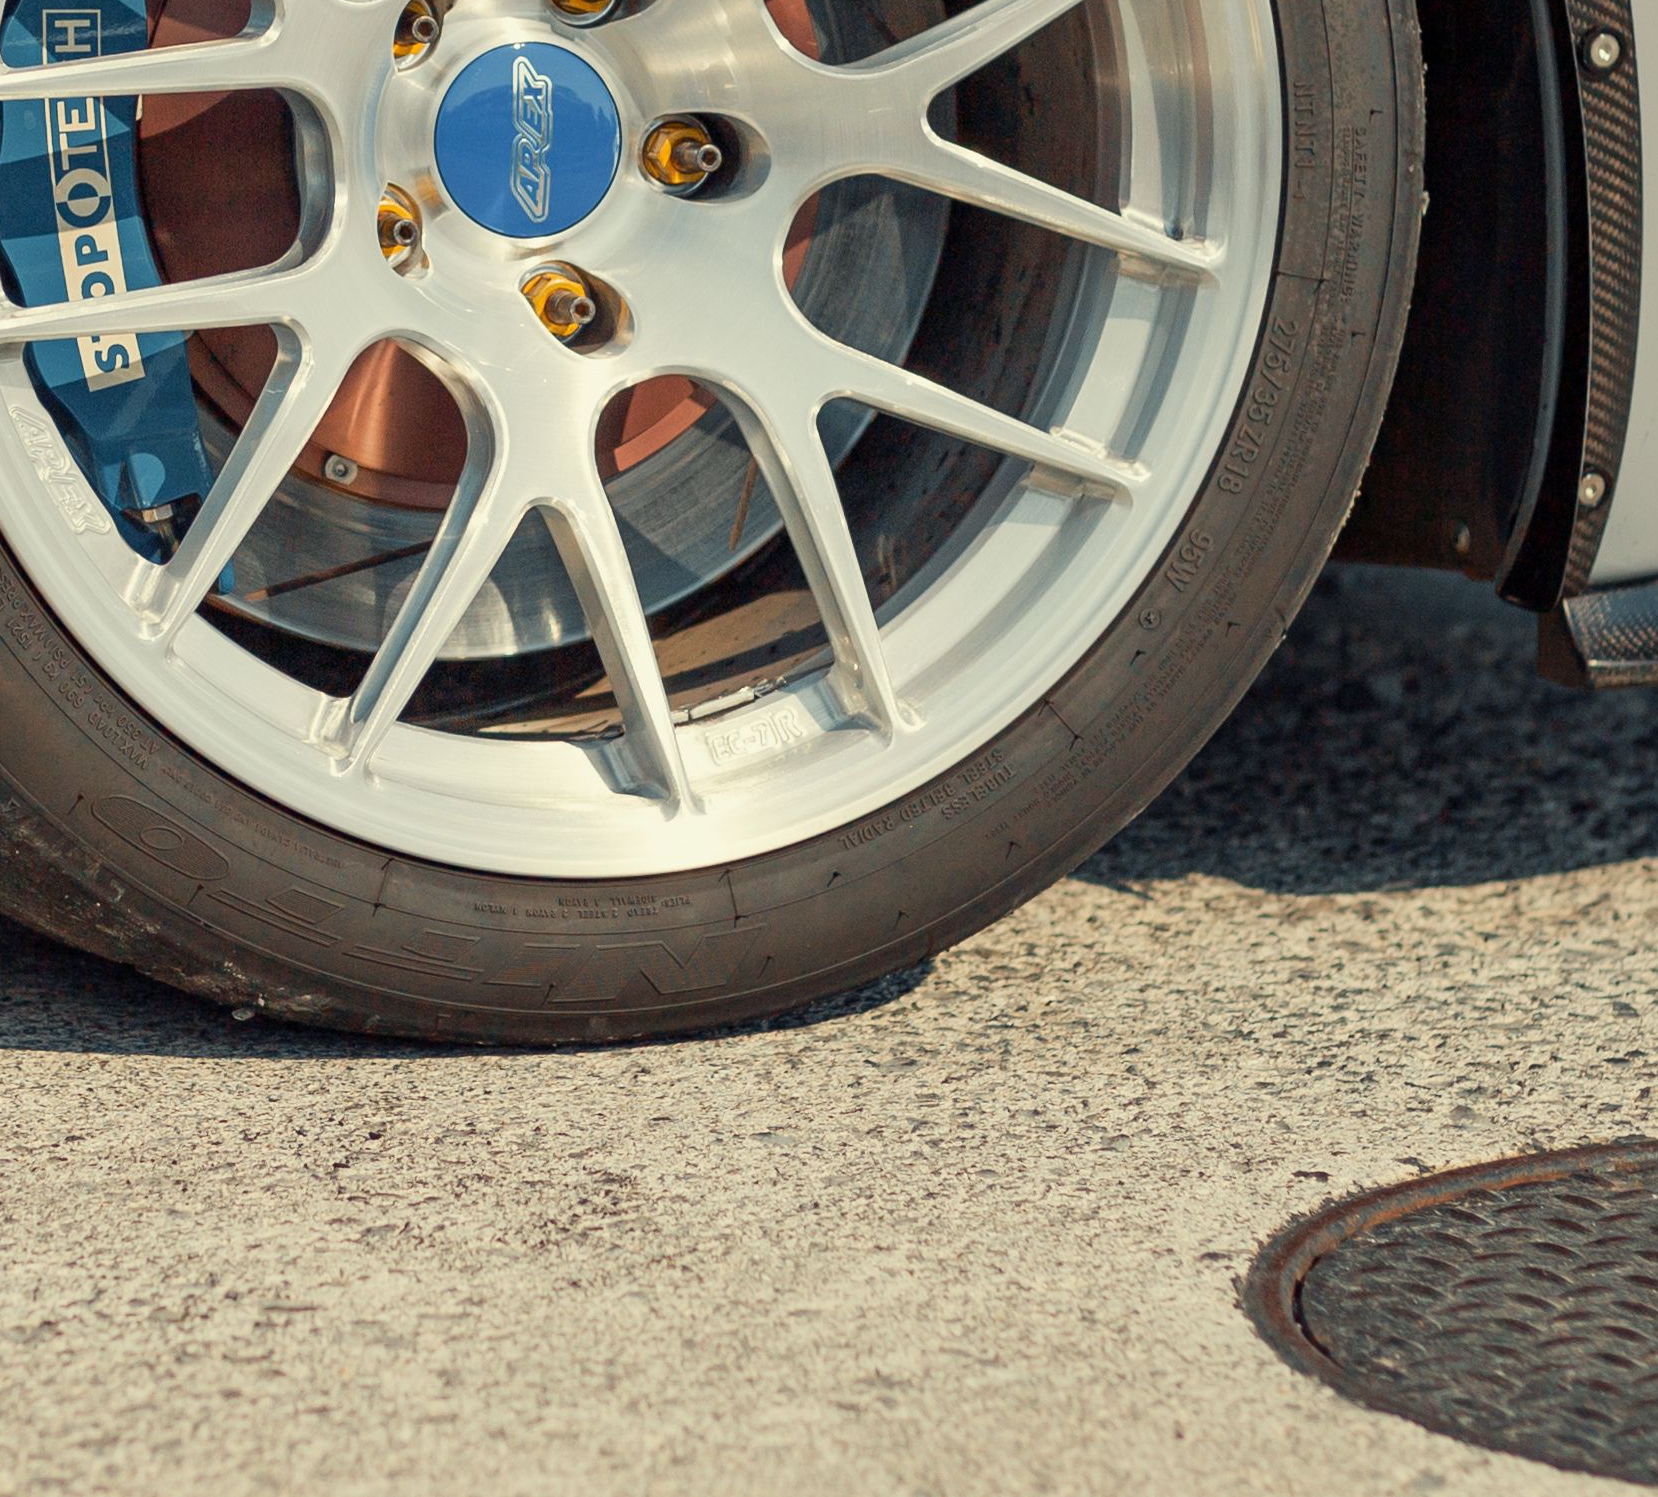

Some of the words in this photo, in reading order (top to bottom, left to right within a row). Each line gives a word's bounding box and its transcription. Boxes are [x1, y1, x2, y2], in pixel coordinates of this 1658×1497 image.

[510, 56, 553, 223] APEX
[1167, 527, 1215, 594] 95W
[55, 678, 87, 711] 690
[114, 712, 143, 742] 350
[137, 733, 160, 757] AT
[955, 745, 1006, 789] STEEL
[896, 779, 956, 824] BELTED
[937, 759, 1017, 823] TUBELESS
[837, 812, 896, 852] RADIAL
